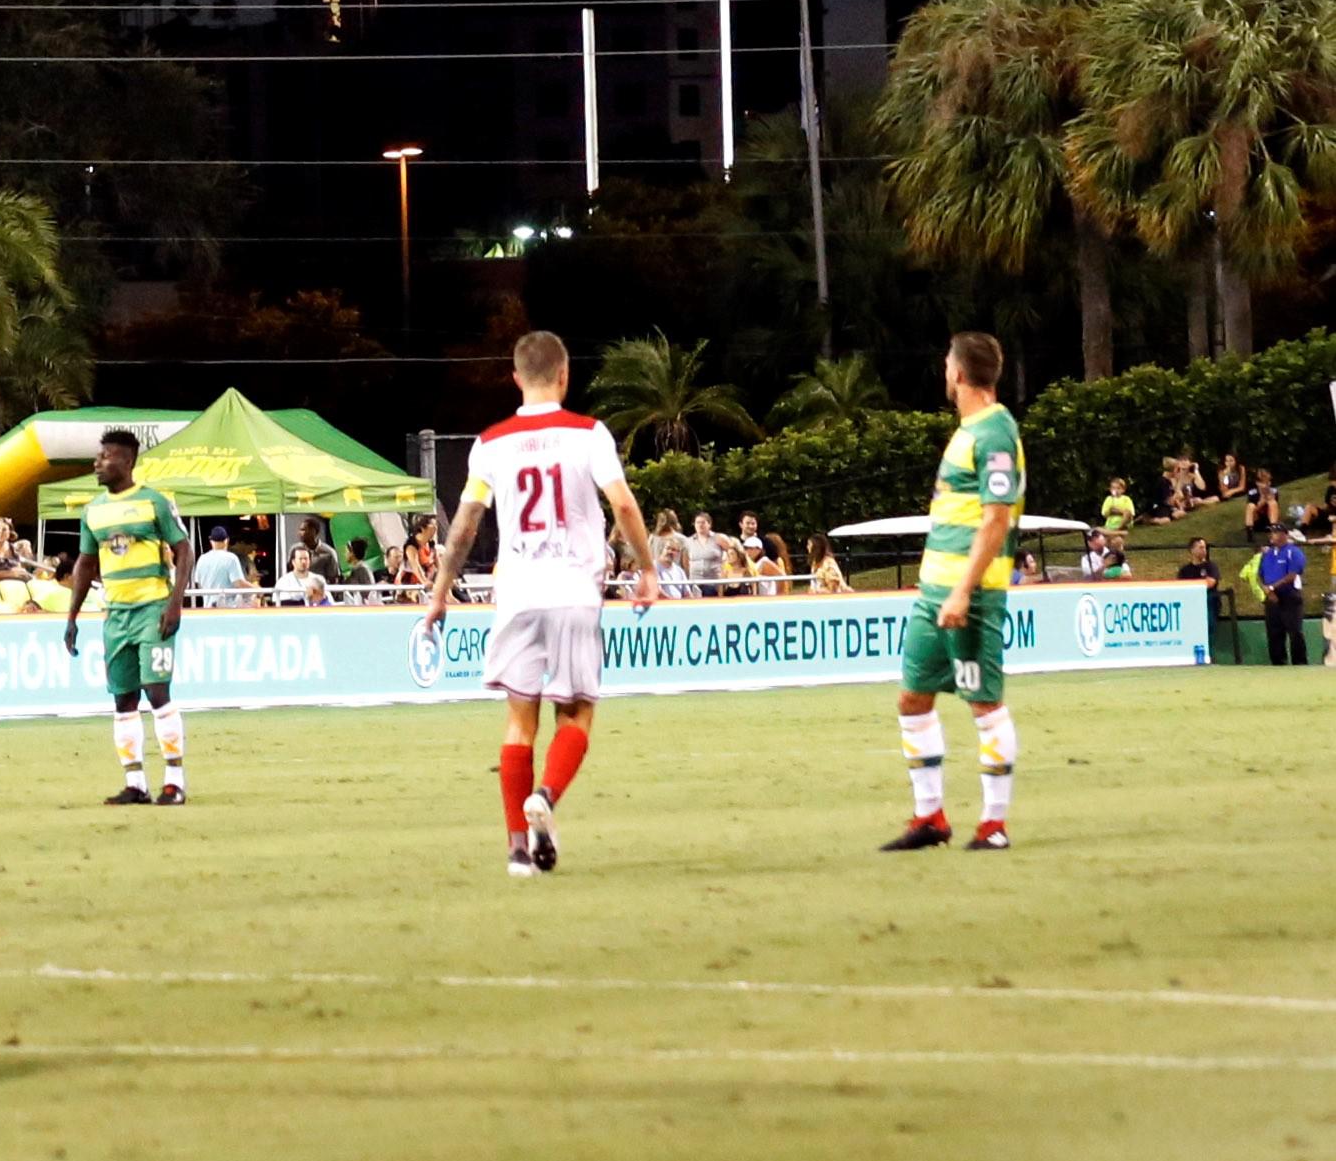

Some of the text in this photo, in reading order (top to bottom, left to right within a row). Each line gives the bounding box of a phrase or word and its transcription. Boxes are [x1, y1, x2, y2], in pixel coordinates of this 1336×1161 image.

[516, 461, 567, 533] 21
[1103, 602, 1181, 634] CARCREDIT
[82, 635, 327, 688] GNTIZADA
[151, 646, 174, 673] 29
